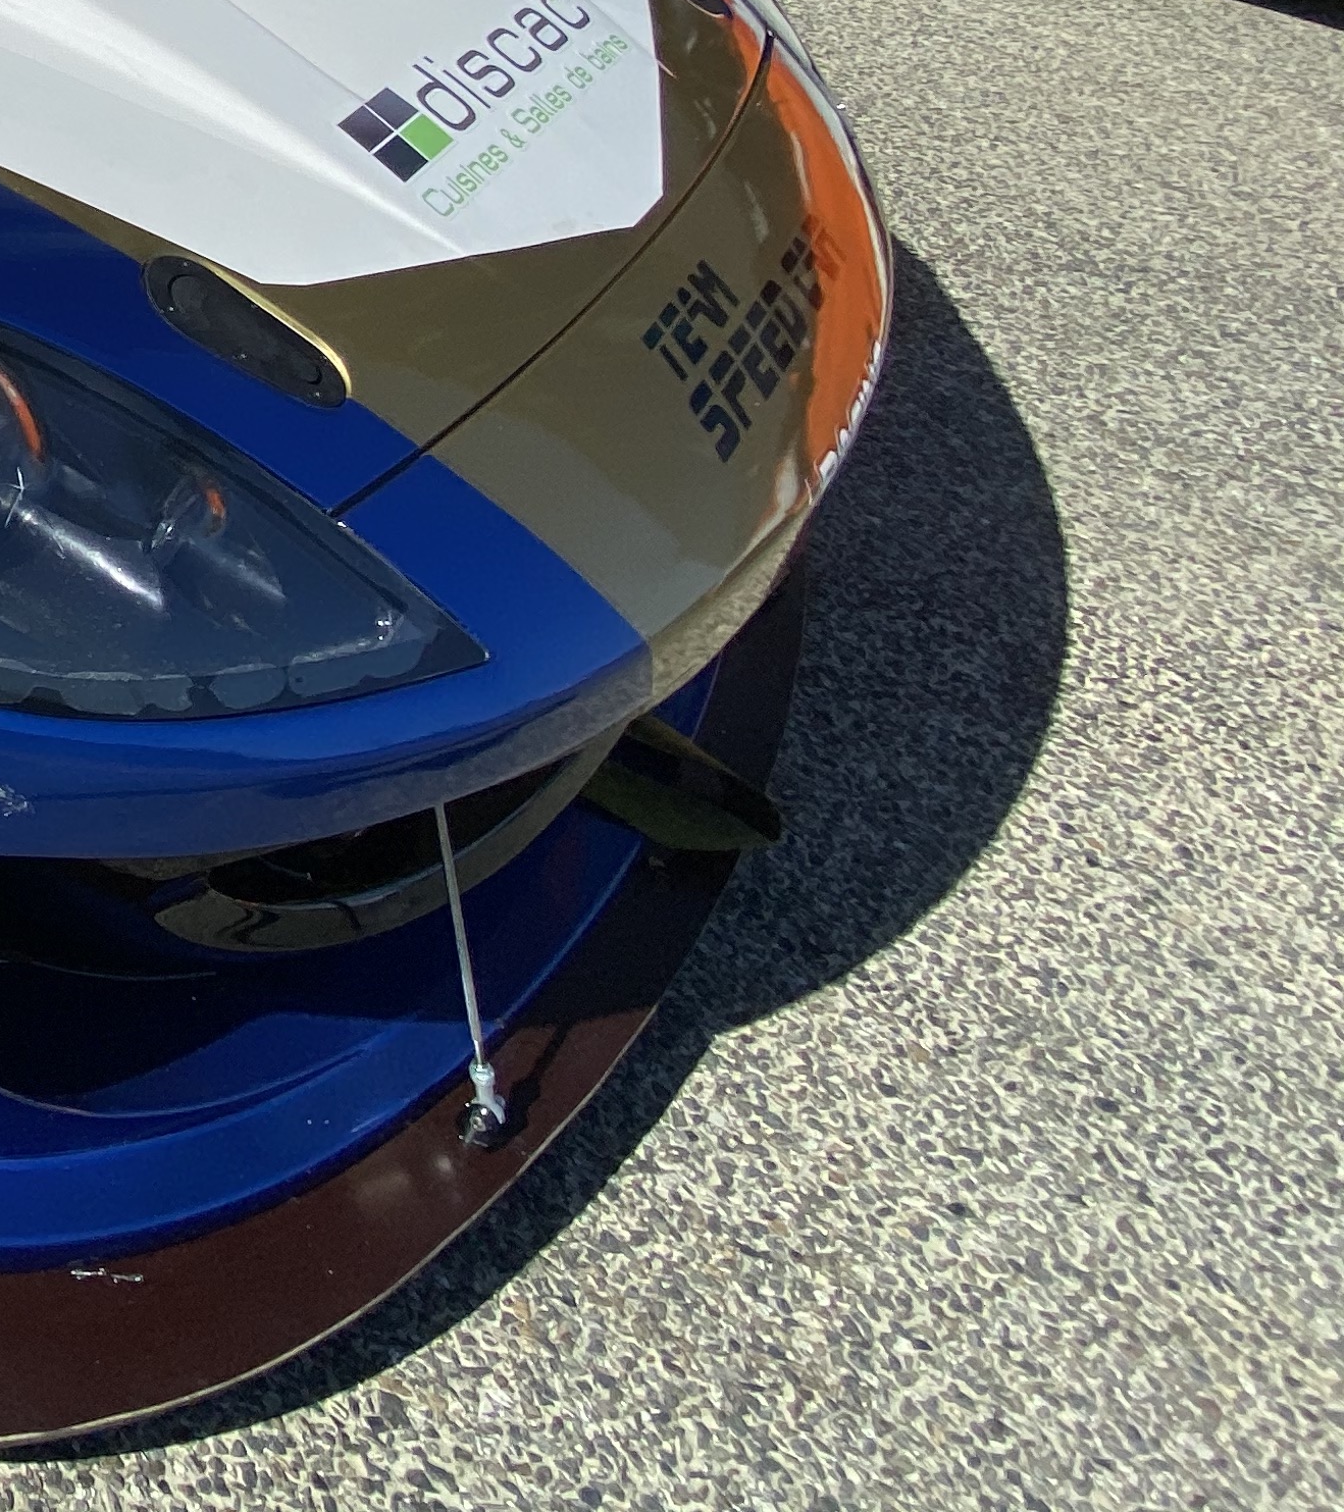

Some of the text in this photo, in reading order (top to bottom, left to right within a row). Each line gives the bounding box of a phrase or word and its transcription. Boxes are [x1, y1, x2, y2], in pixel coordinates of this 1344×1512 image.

[421, 34, 629, 217] Cuisines & Salles de bains
[641, 259, 740, 382] TEAM
